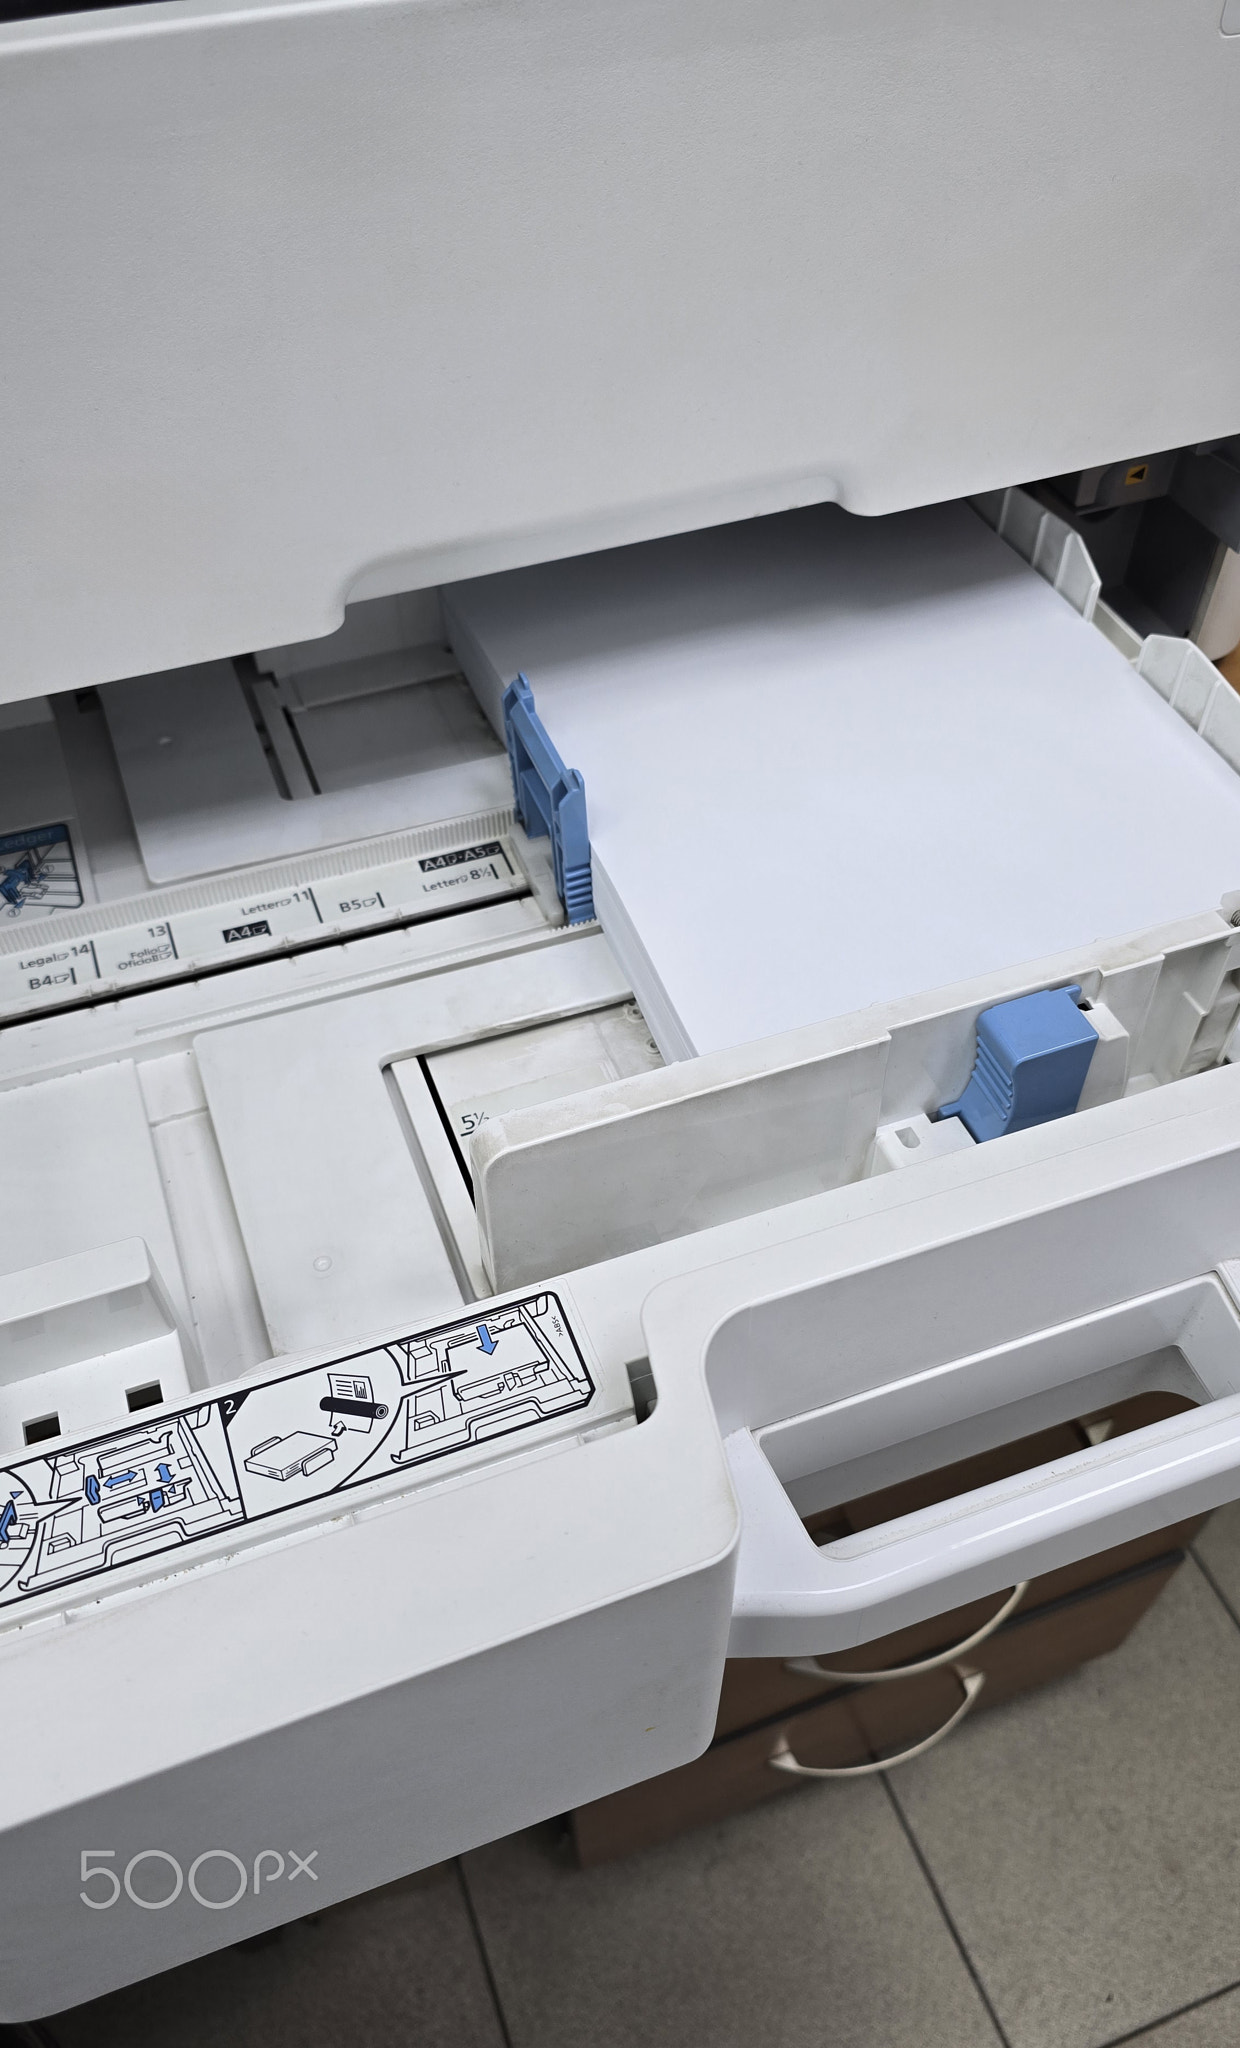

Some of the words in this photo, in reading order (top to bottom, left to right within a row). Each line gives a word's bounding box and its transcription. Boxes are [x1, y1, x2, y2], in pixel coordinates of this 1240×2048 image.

[422, 875, 460, 892] Letter
[241, 901, 281, 916] Letter
[293, 890, 310, 902] 11
[339, 899, 362, 913] B5
[147, 925, 167, 938] 13
[227, 926, 252, 942] A4
[19, 954, 58, 970] Legal
[70, 943, 90, 957] 14
[130, 948, 158, 960] Folio
[29, 974, 54, 990] B4
[224, 1400, 237, 1415] 2
